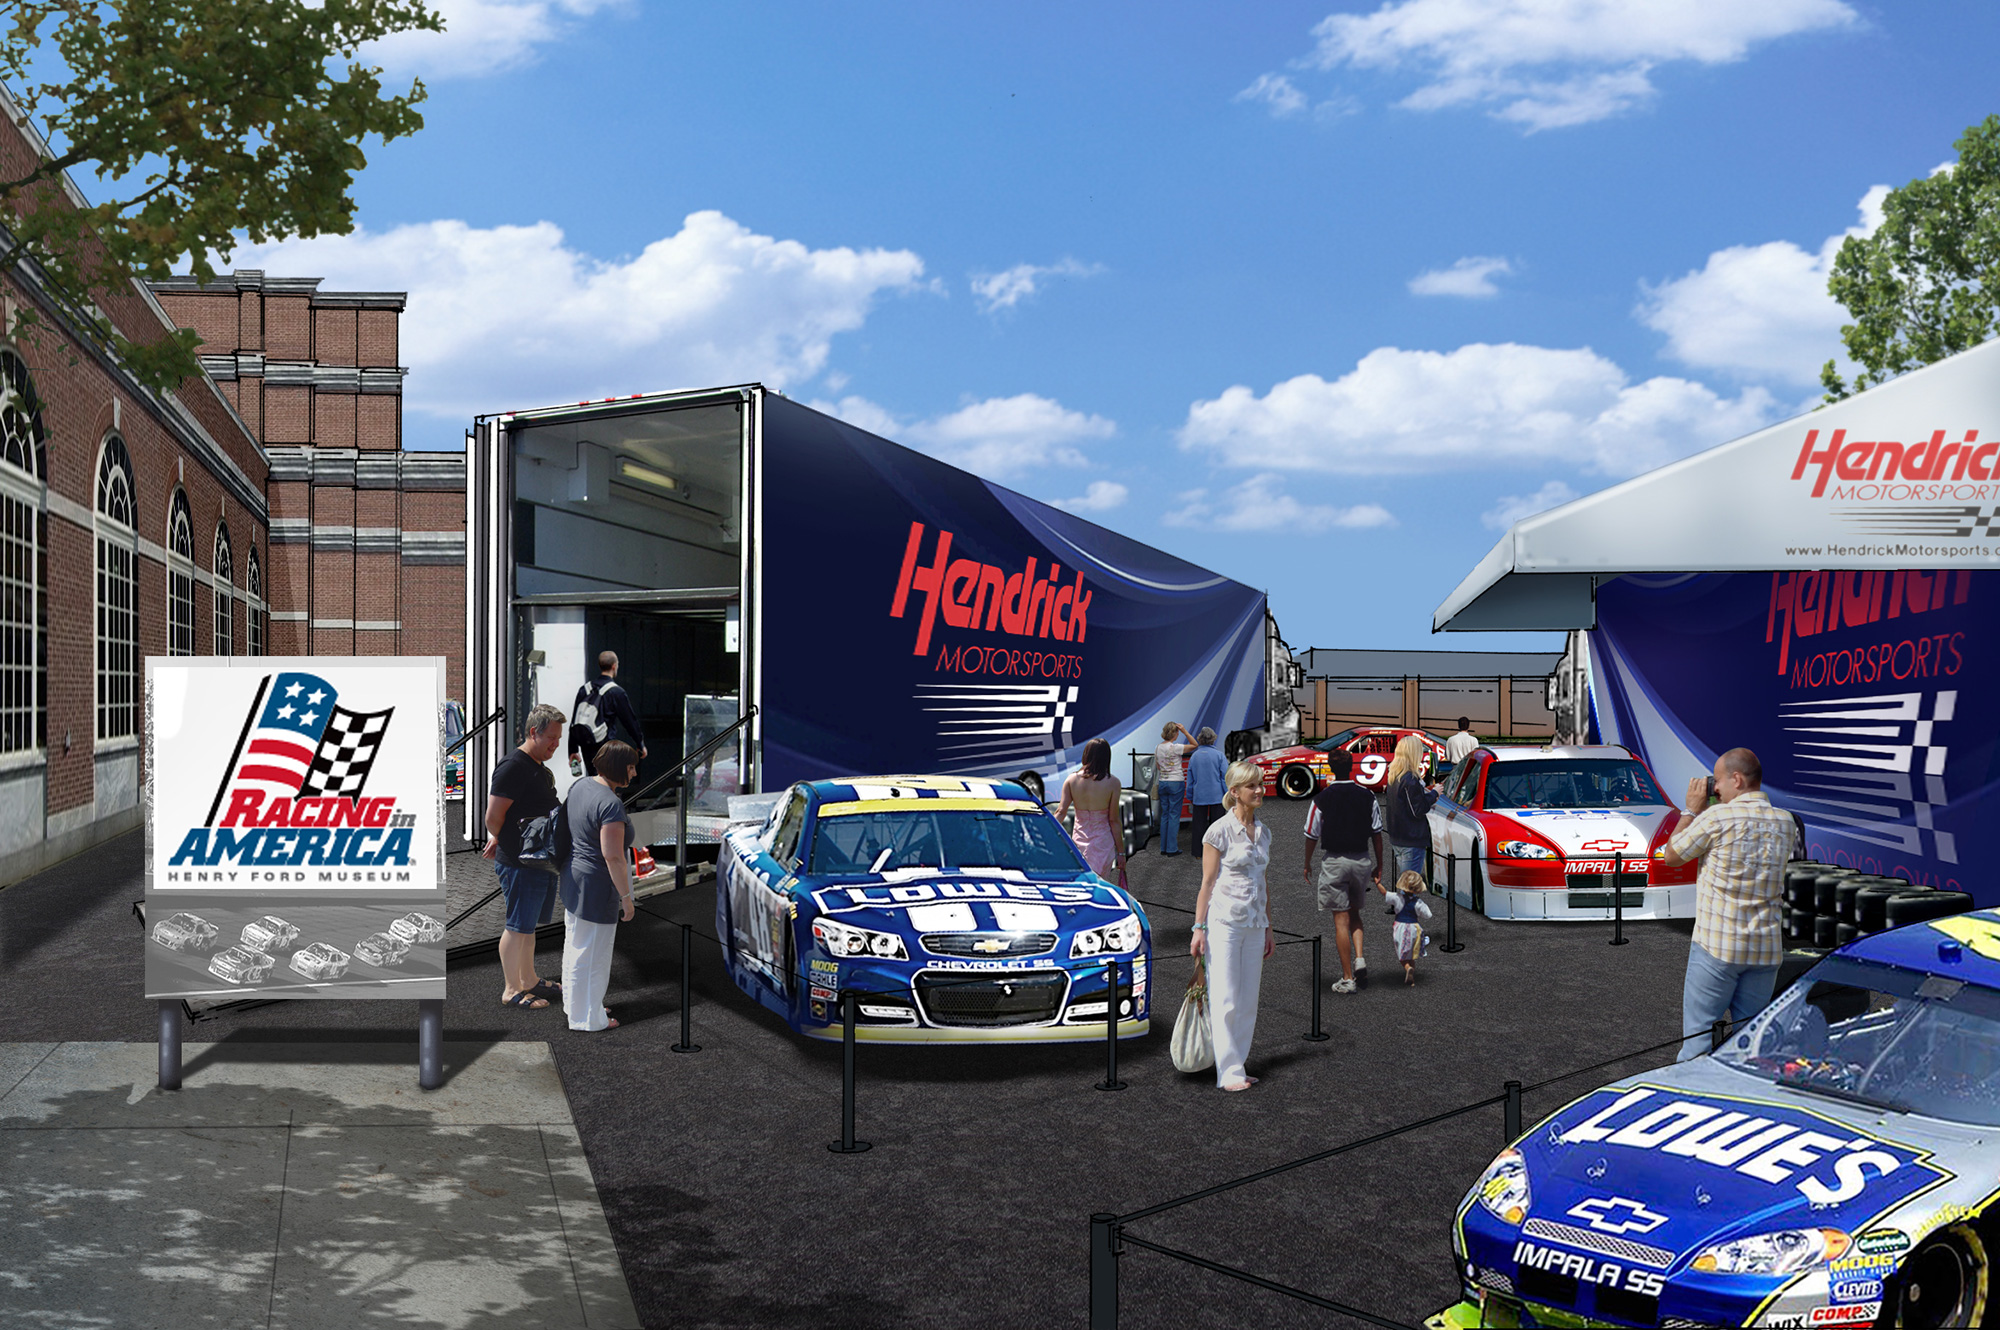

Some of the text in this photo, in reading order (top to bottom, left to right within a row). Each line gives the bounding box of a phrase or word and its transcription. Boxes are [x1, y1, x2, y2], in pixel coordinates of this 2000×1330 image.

[1790, 429, 2000, 498] Hendric
[889, 521, 1093, 656] Hendrick
[935, 643, 1083, 679] MOTORSPORTS
[1790, 632, 1965, 690] MOTORSPORTS
[1355, 754, 1388, 785] 9
[219, 789, 416, 827] RACING in
[168, 828, 414, 866] AMERICA
[168, 872, 411, 882] HENRY FORD MUSEUM
[1627, 860, 1650, 872] SS
[850, 881, 1094, 904] LOWE'S
[810, 959, 839, 973] MOOG
[926, 959, 1055, 970] CHEVROLET SS
[1562, 1088, 1902, 1204] LOWE'S
[1513, 1240, 1667, 1297] IMPALA SS
[1830, 1253, 1894, 1272] MOOG
[1834, 1280, 1880, 1298] CLEVITE
[1812, 1305, 1862, 1321] COMP
